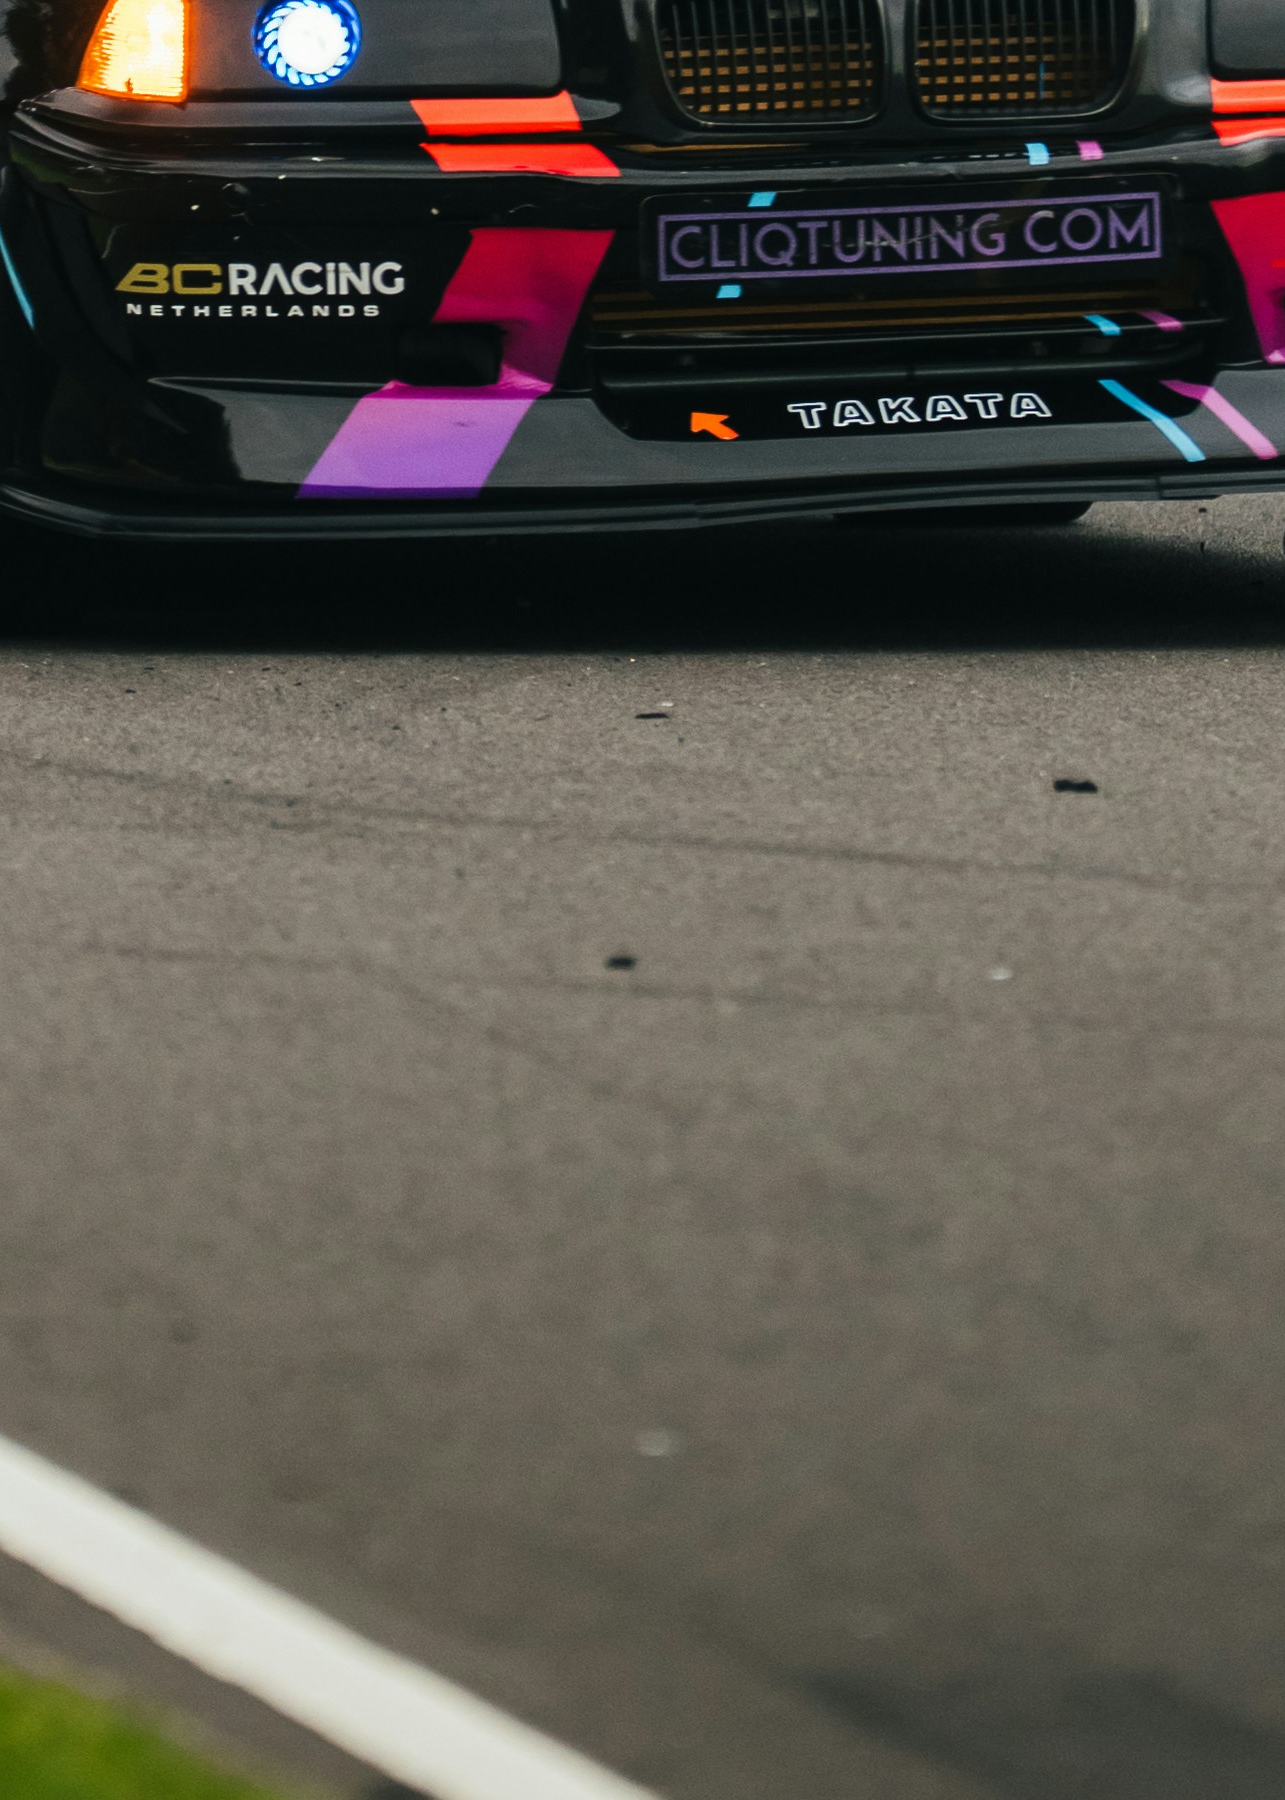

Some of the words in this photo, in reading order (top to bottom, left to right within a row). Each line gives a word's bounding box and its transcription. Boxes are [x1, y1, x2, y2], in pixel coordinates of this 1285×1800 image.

[670, 212, 1006, 269] CLIQTUNING
[1023, 204, 1150, 254] COM
[126, 303, 380, 317] NETHERLANDS
[787, 392, 1053, 430] TAKATA
